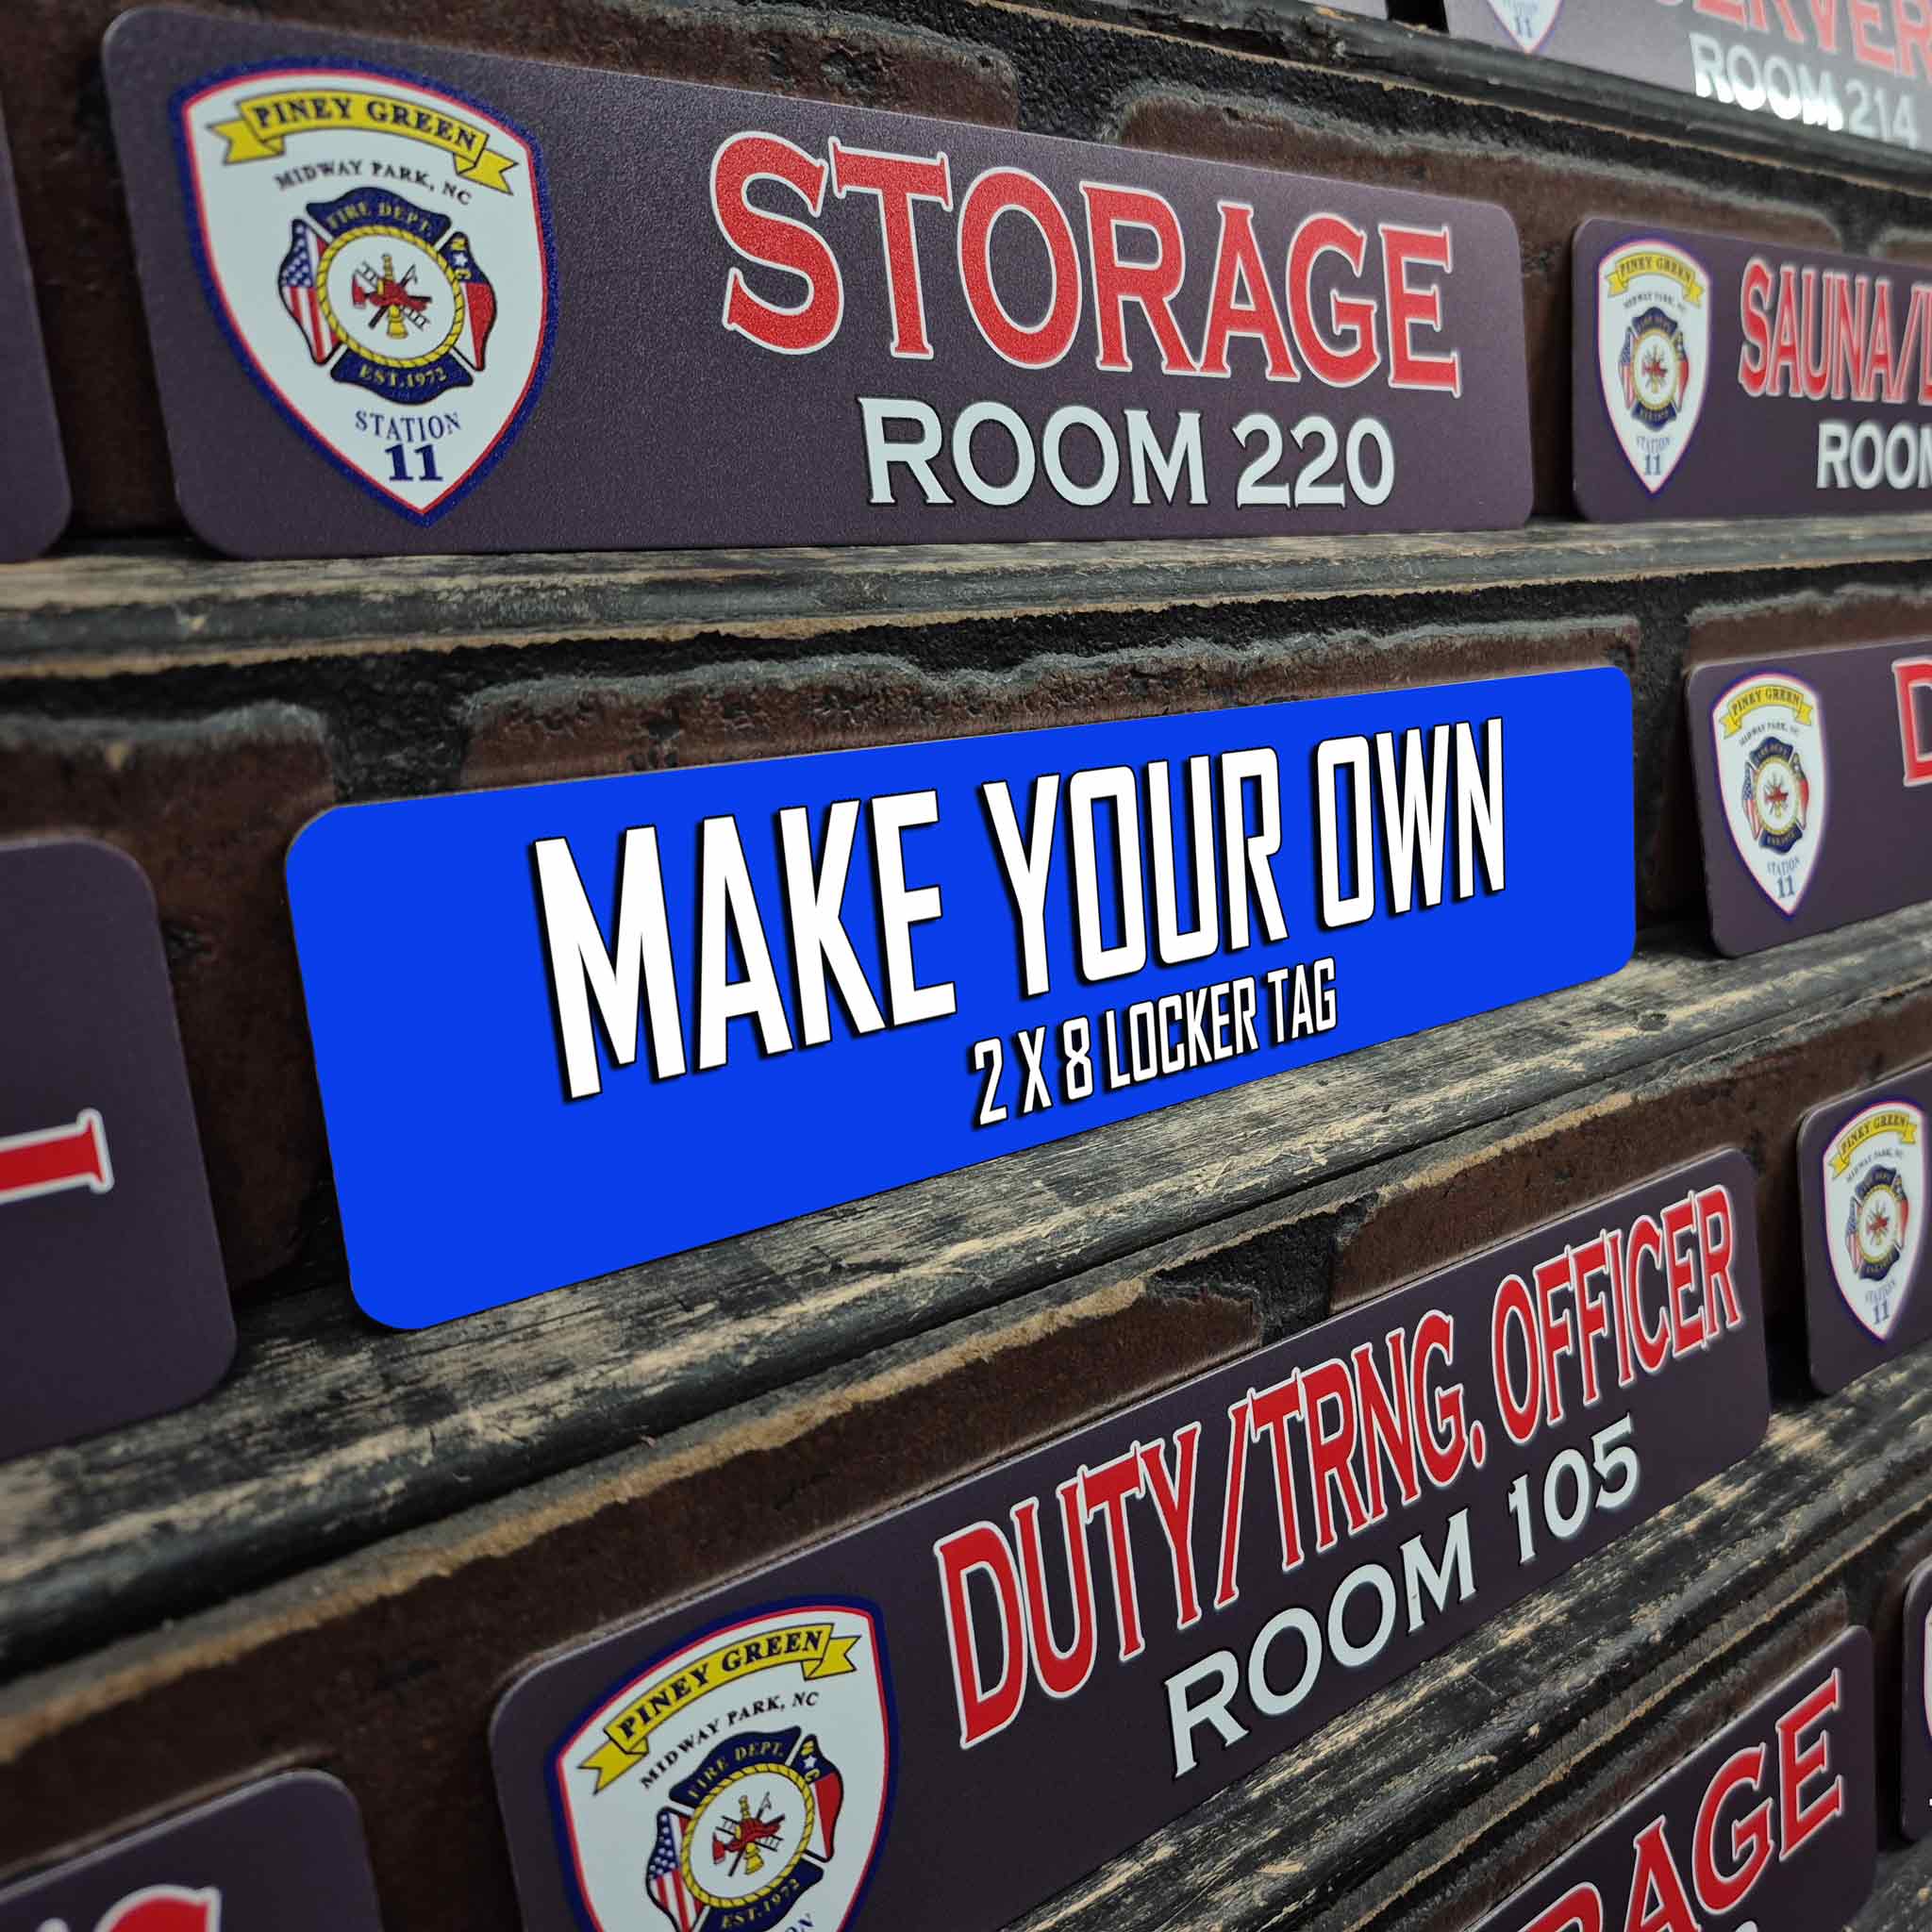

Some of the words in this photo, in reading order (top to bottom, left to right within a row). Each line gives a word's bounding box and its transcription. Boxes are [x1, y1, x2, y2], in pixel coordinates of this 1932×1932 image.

[252, 95, 354, 129] PINEY
[367, 100, 476, 156] GREEN
[1689, 31, 1844, 132] ROOM
[1845, 77, 1919, 150] 214
[275, 159, 363, 189] MIDWAY
[371, 161, 435, 192] PARK,
[442, 181, 472, 206] NC
[326, 201, 372, 228] FIRE
[710, 130, 1461, 398] STORAGE
[355, 408, 462, 443] STATION
[385, 443, 444, 482] 11
[858, 396, 1209, 507] ROOM
[1232, 413, 1395, 508] 220
[1644, 454, 1662, 476] 11
[531, 789, 958, 1101] MAKE
[979, 746, 1290, 1000] YOUR
[1315, 717, 1506, 929] OWN
[1776, 874, 1795, 899] 11
[973, 1038, 1008, 1127] 2
[1017, 1026, 1052, 1115] X
[1063, 1016, 1095, 1102] 8
[1106, 975, 1259, 1090] LOCKER
[1267, 956, 1338, 1044] TAG
[1873, 1299, 1890, 1325] 11
[934, 1308, 1488, 1750] DUTY/TRNG.
[1491, 1183, 1740, 1446] OFFICER
[1164, 1510, 1478, 1780] ROOM
[1507, 1413, 1642, 1567] 105
[618, 1662, 710, 1741] PINEY
[721, 1629, 824, 1674] GREEN
[640, 1718, 721, 1790] MIDWAY
[726, 1697, 786, 1728] PARK,
[791, 1690, 820, 1708] NC
[687, 1754, 730, 1801] FIRE
